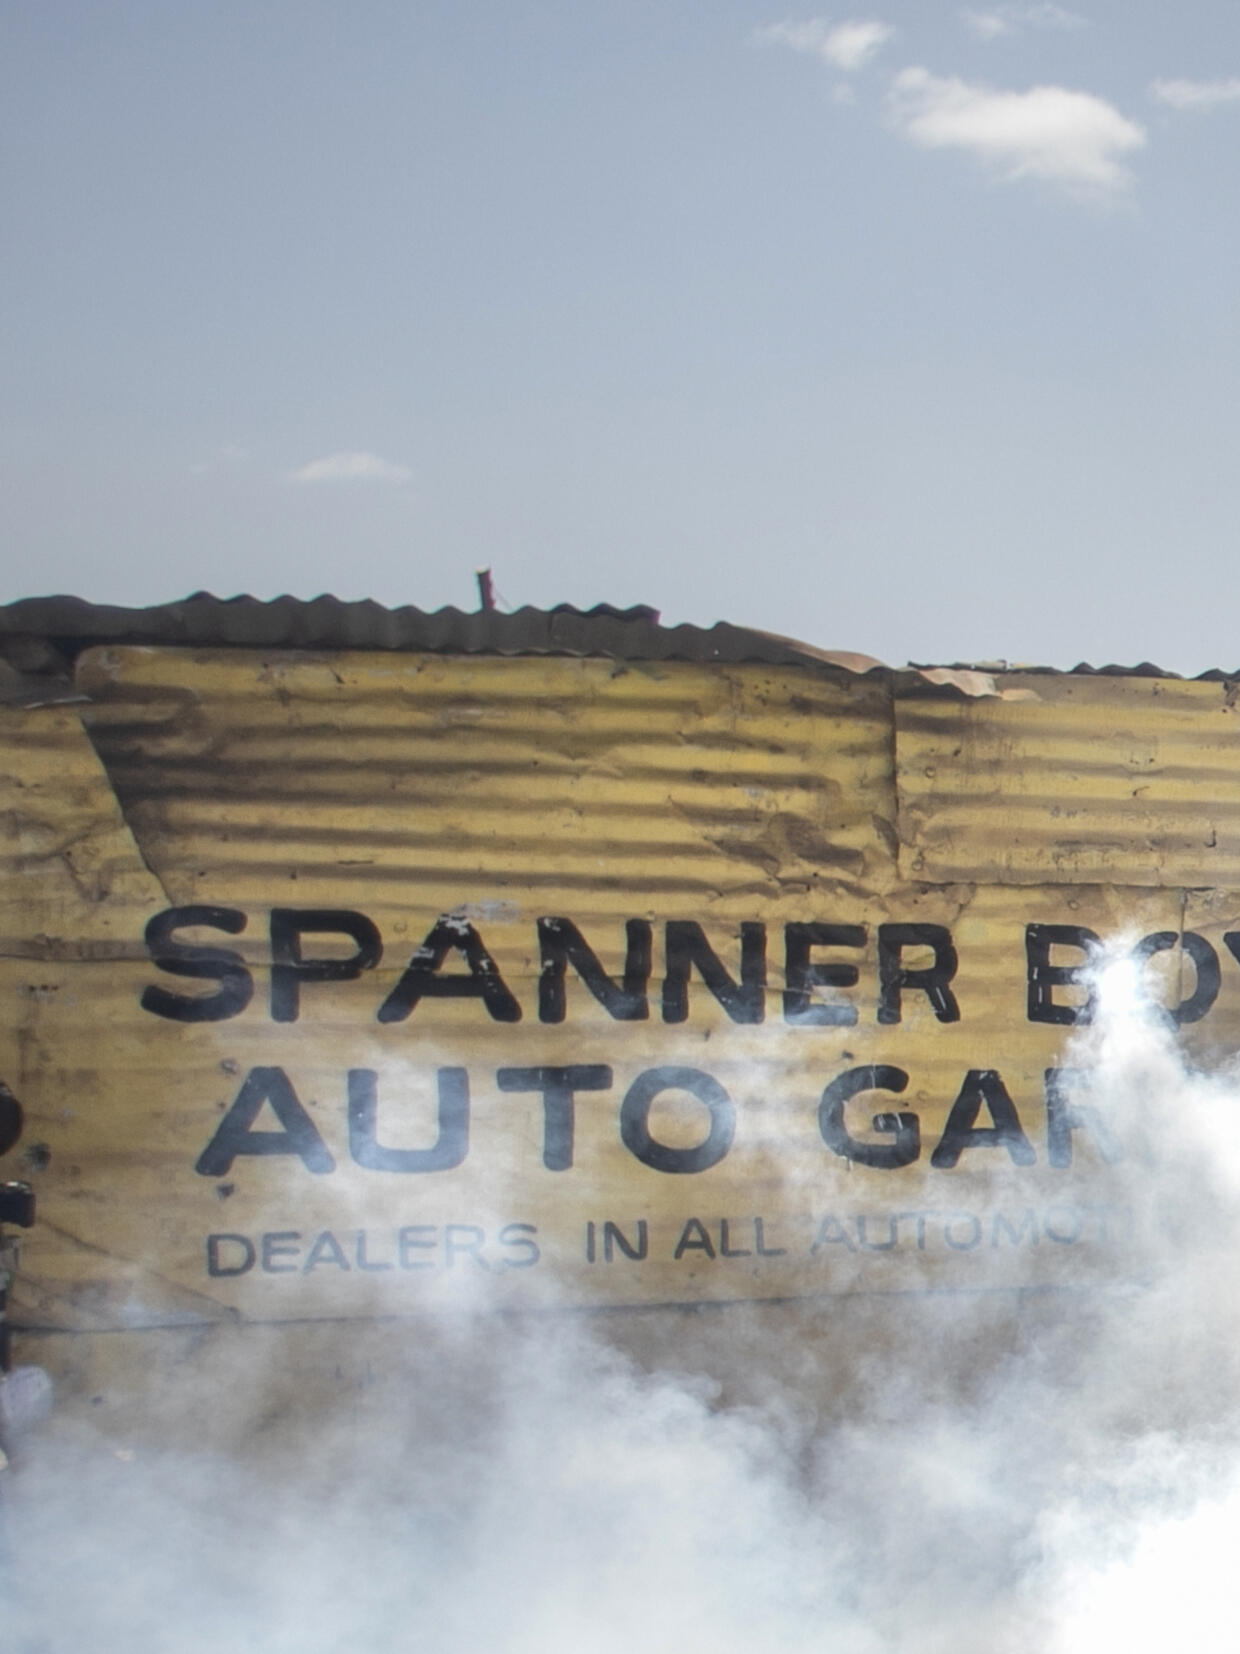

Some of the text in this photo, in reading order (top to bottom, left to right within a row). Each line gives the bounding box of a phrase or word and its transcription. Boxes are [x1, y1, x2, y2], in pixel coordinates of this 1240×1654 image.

[141, 905, 961, 1024] SPANNER
[195, 1064, 737, 1176] AUTO
[206, 1223, 541, 1278] DEALERS
[585, 1218, 649, 1264] IN
[673, 1216, 787, 1260] ALL
